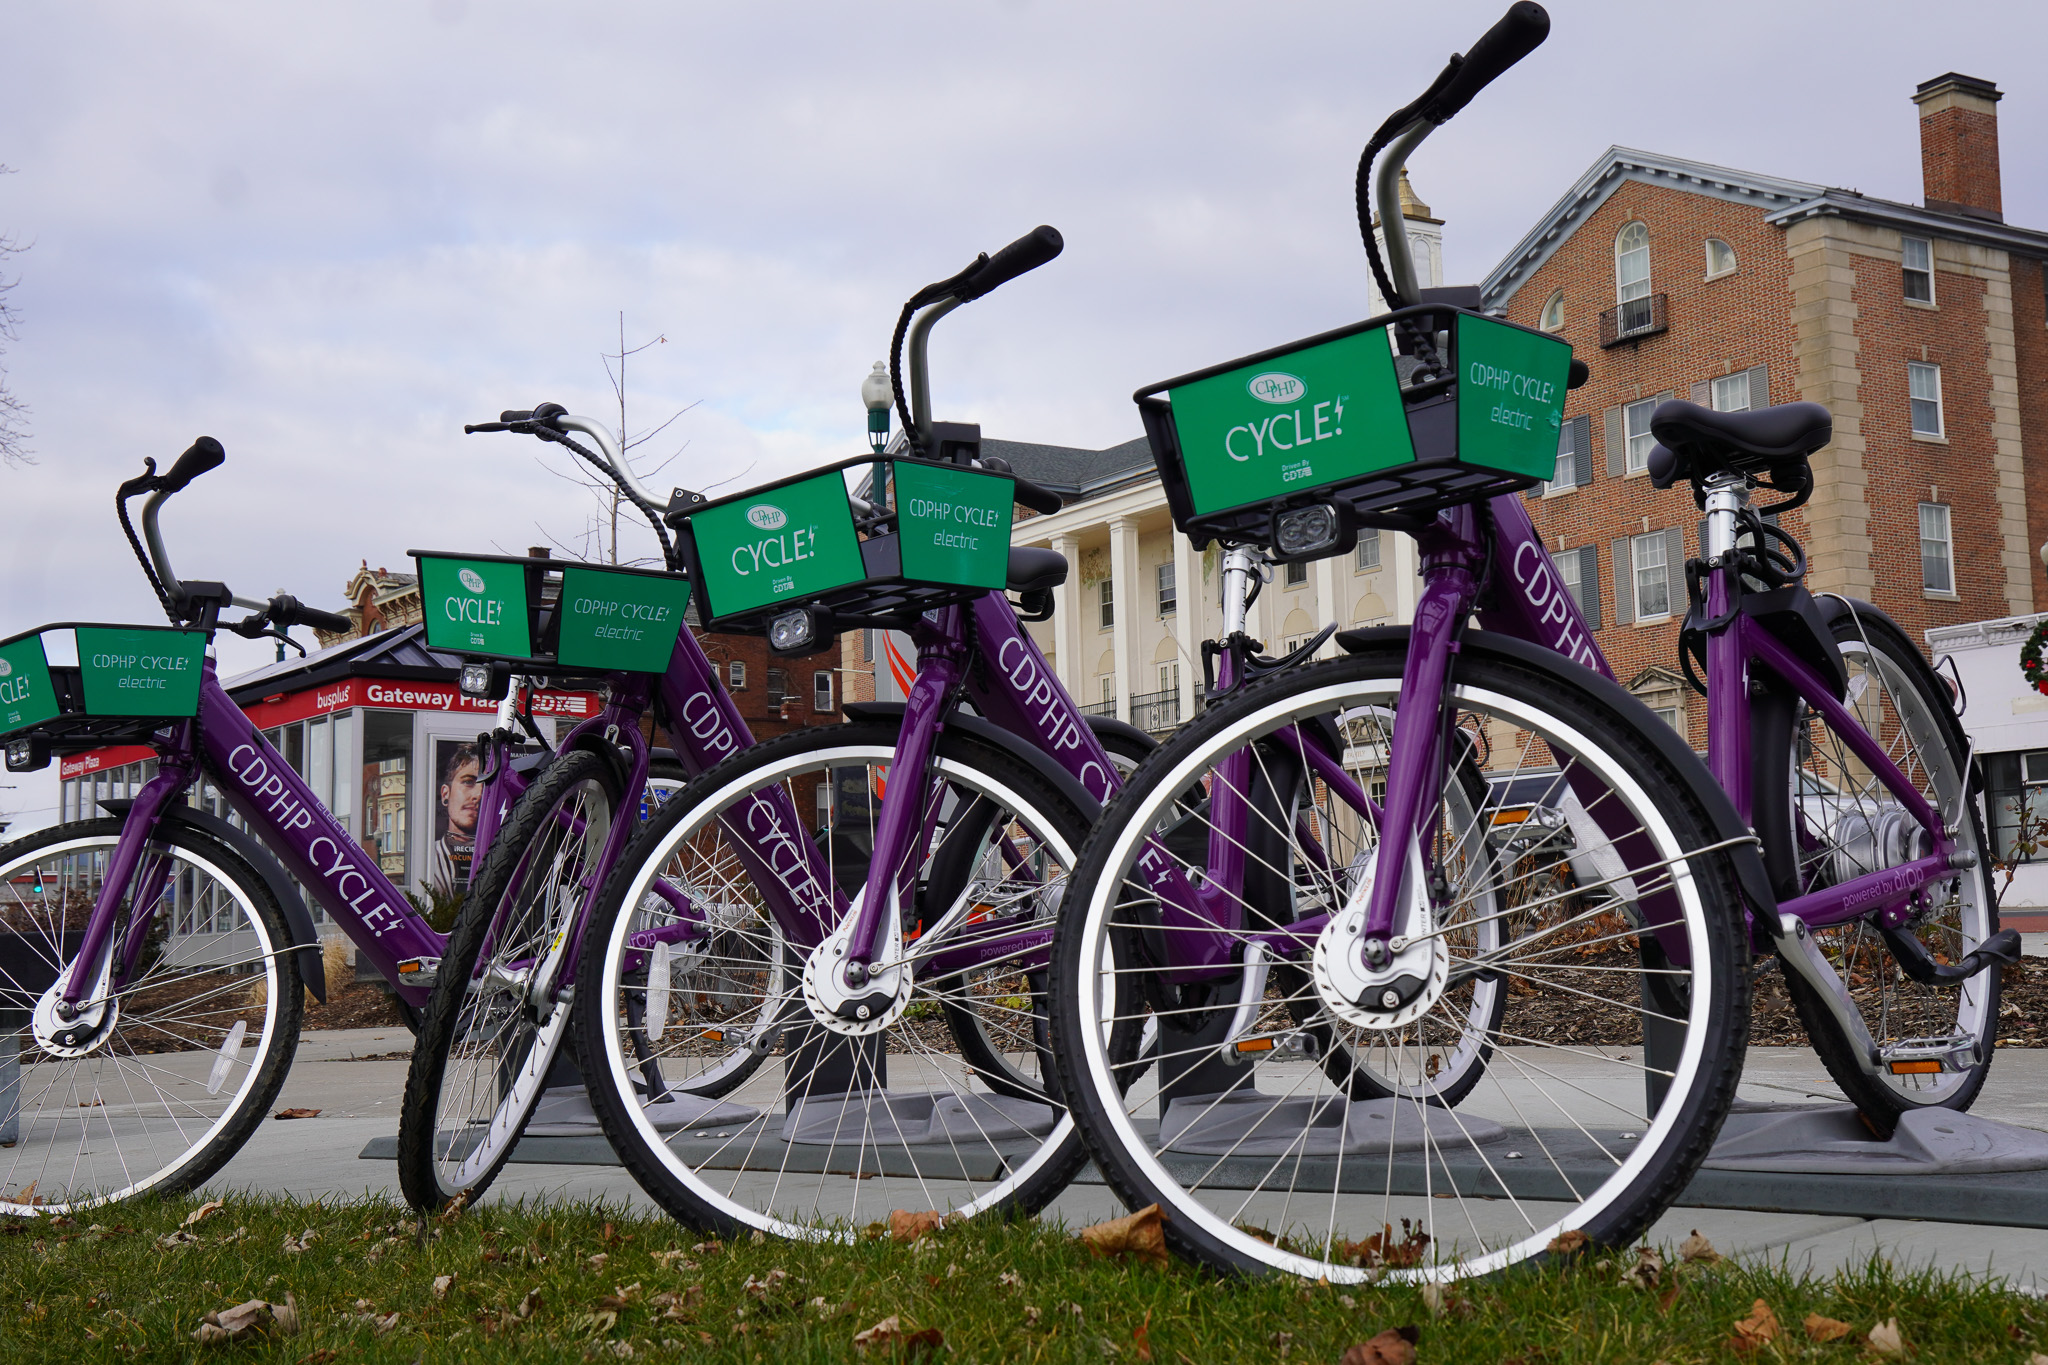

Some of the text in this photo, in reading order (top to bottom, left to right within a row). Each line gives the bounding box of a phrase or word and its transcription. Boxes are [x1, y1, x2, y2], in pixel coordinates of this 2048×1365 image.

[1470, 361, 1554, 404] CDPHP CYCLE!
[1225, 393, 1344, 462] CYCLE!
[1491, 404, 1533, 431] electric
[1282, 459, 1309, 471] Driven By
[910, 499, 999, 528] CDPHP CYCLE!
[732, 524, 816, 576] CYCLE!
[933, 529, 978, 550] electric
[445, 597, 501, 625] CYCLE!
[574, 598, 669, 622] CDPHP CYCLE!
[595, 624, 644, 641] electric
[93, 654, 188, 670] CDPHP CYCLE!
[0, 672, 30, 704] CLE!
[118, 678, 166, 689] electric
[367, 685, 453, 710] Gateway
[999, 637, 1080, 750] CDPHP
[317, 686, 349, 711] busplus
[683, 691, 740, 762] CDP
[62, 755, 99, 775] Gateway Plaza
[228, 744, 312, 830] CDPHP
[747, 800, 829, 914] CYCLE!
[309, 837, 403, 937] CYCLE!
[1843, 882, 1881, 911] powered
[1881, 879, 1893, 895] by
[980, 940, 1024, 959] powered
